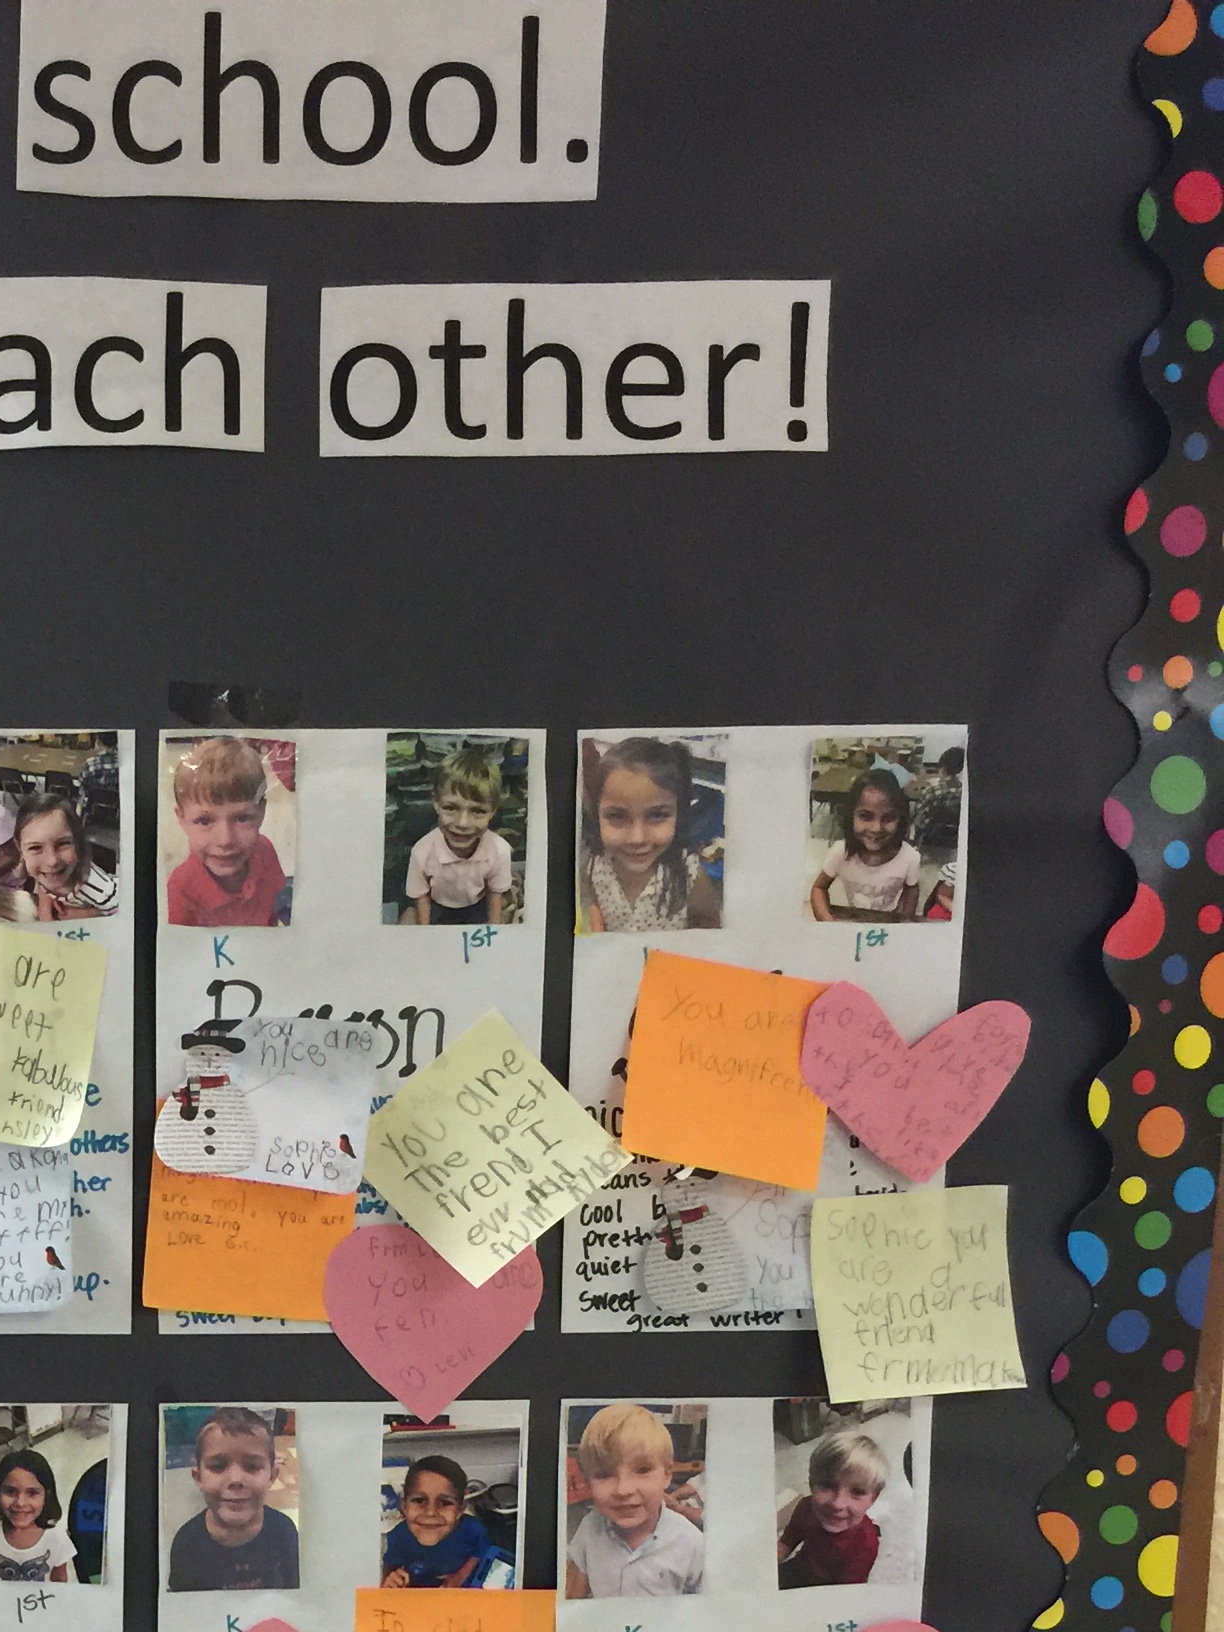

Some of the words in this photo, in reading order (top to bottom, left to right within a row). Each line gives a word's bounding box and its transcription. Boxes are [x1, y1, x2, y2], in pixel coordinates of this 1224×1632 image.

[32, 12, 588, 166] school.
[330, 299, 810, 442] other!
[213, 935, 234, 967] K
